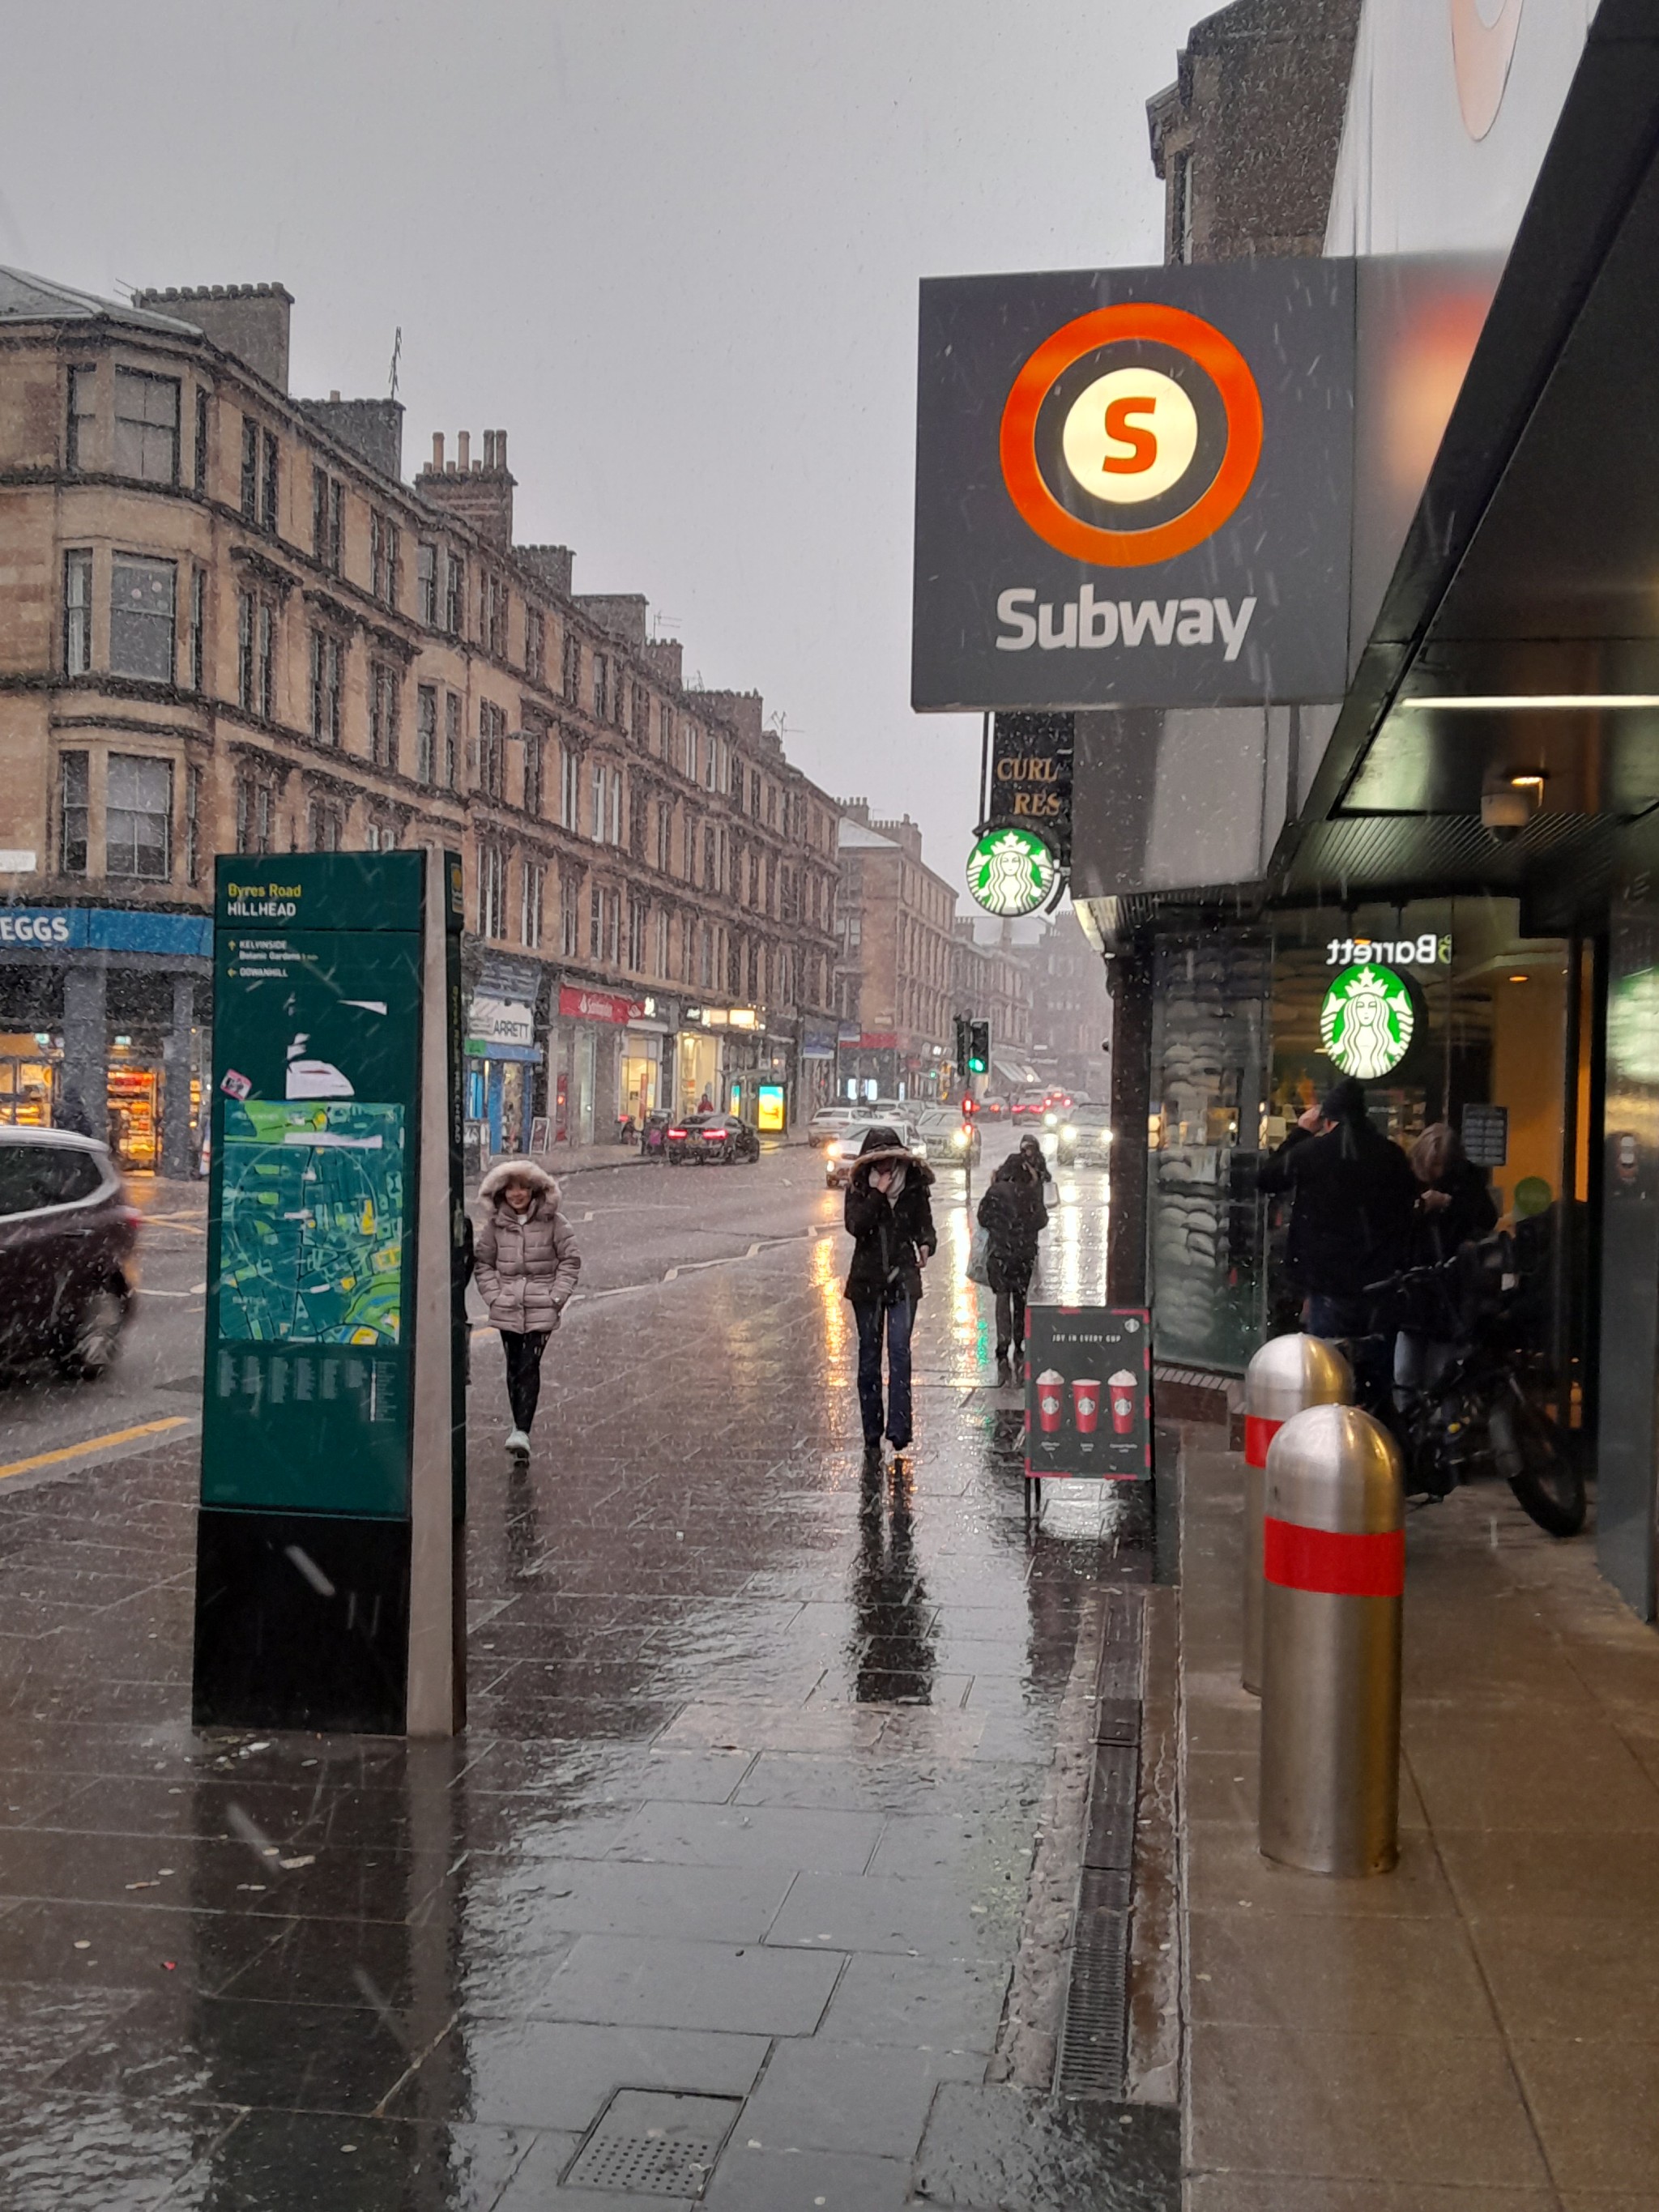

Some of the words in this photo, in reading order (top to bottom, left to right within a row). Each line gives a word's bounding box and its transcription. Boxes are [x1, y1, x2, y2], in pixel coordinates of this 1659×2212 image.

[1102, 396, 1157, 474] S
[996, 583, 1257, 662] Subway
[228, 883, 266, 901] Byres
[269, 883, 301, 897] Road
[228, 901, 296, 917] HILLHEAD
[0, 916, 69, 941] EGGS
[239, 940, 287, 949] KELVINSIDE
